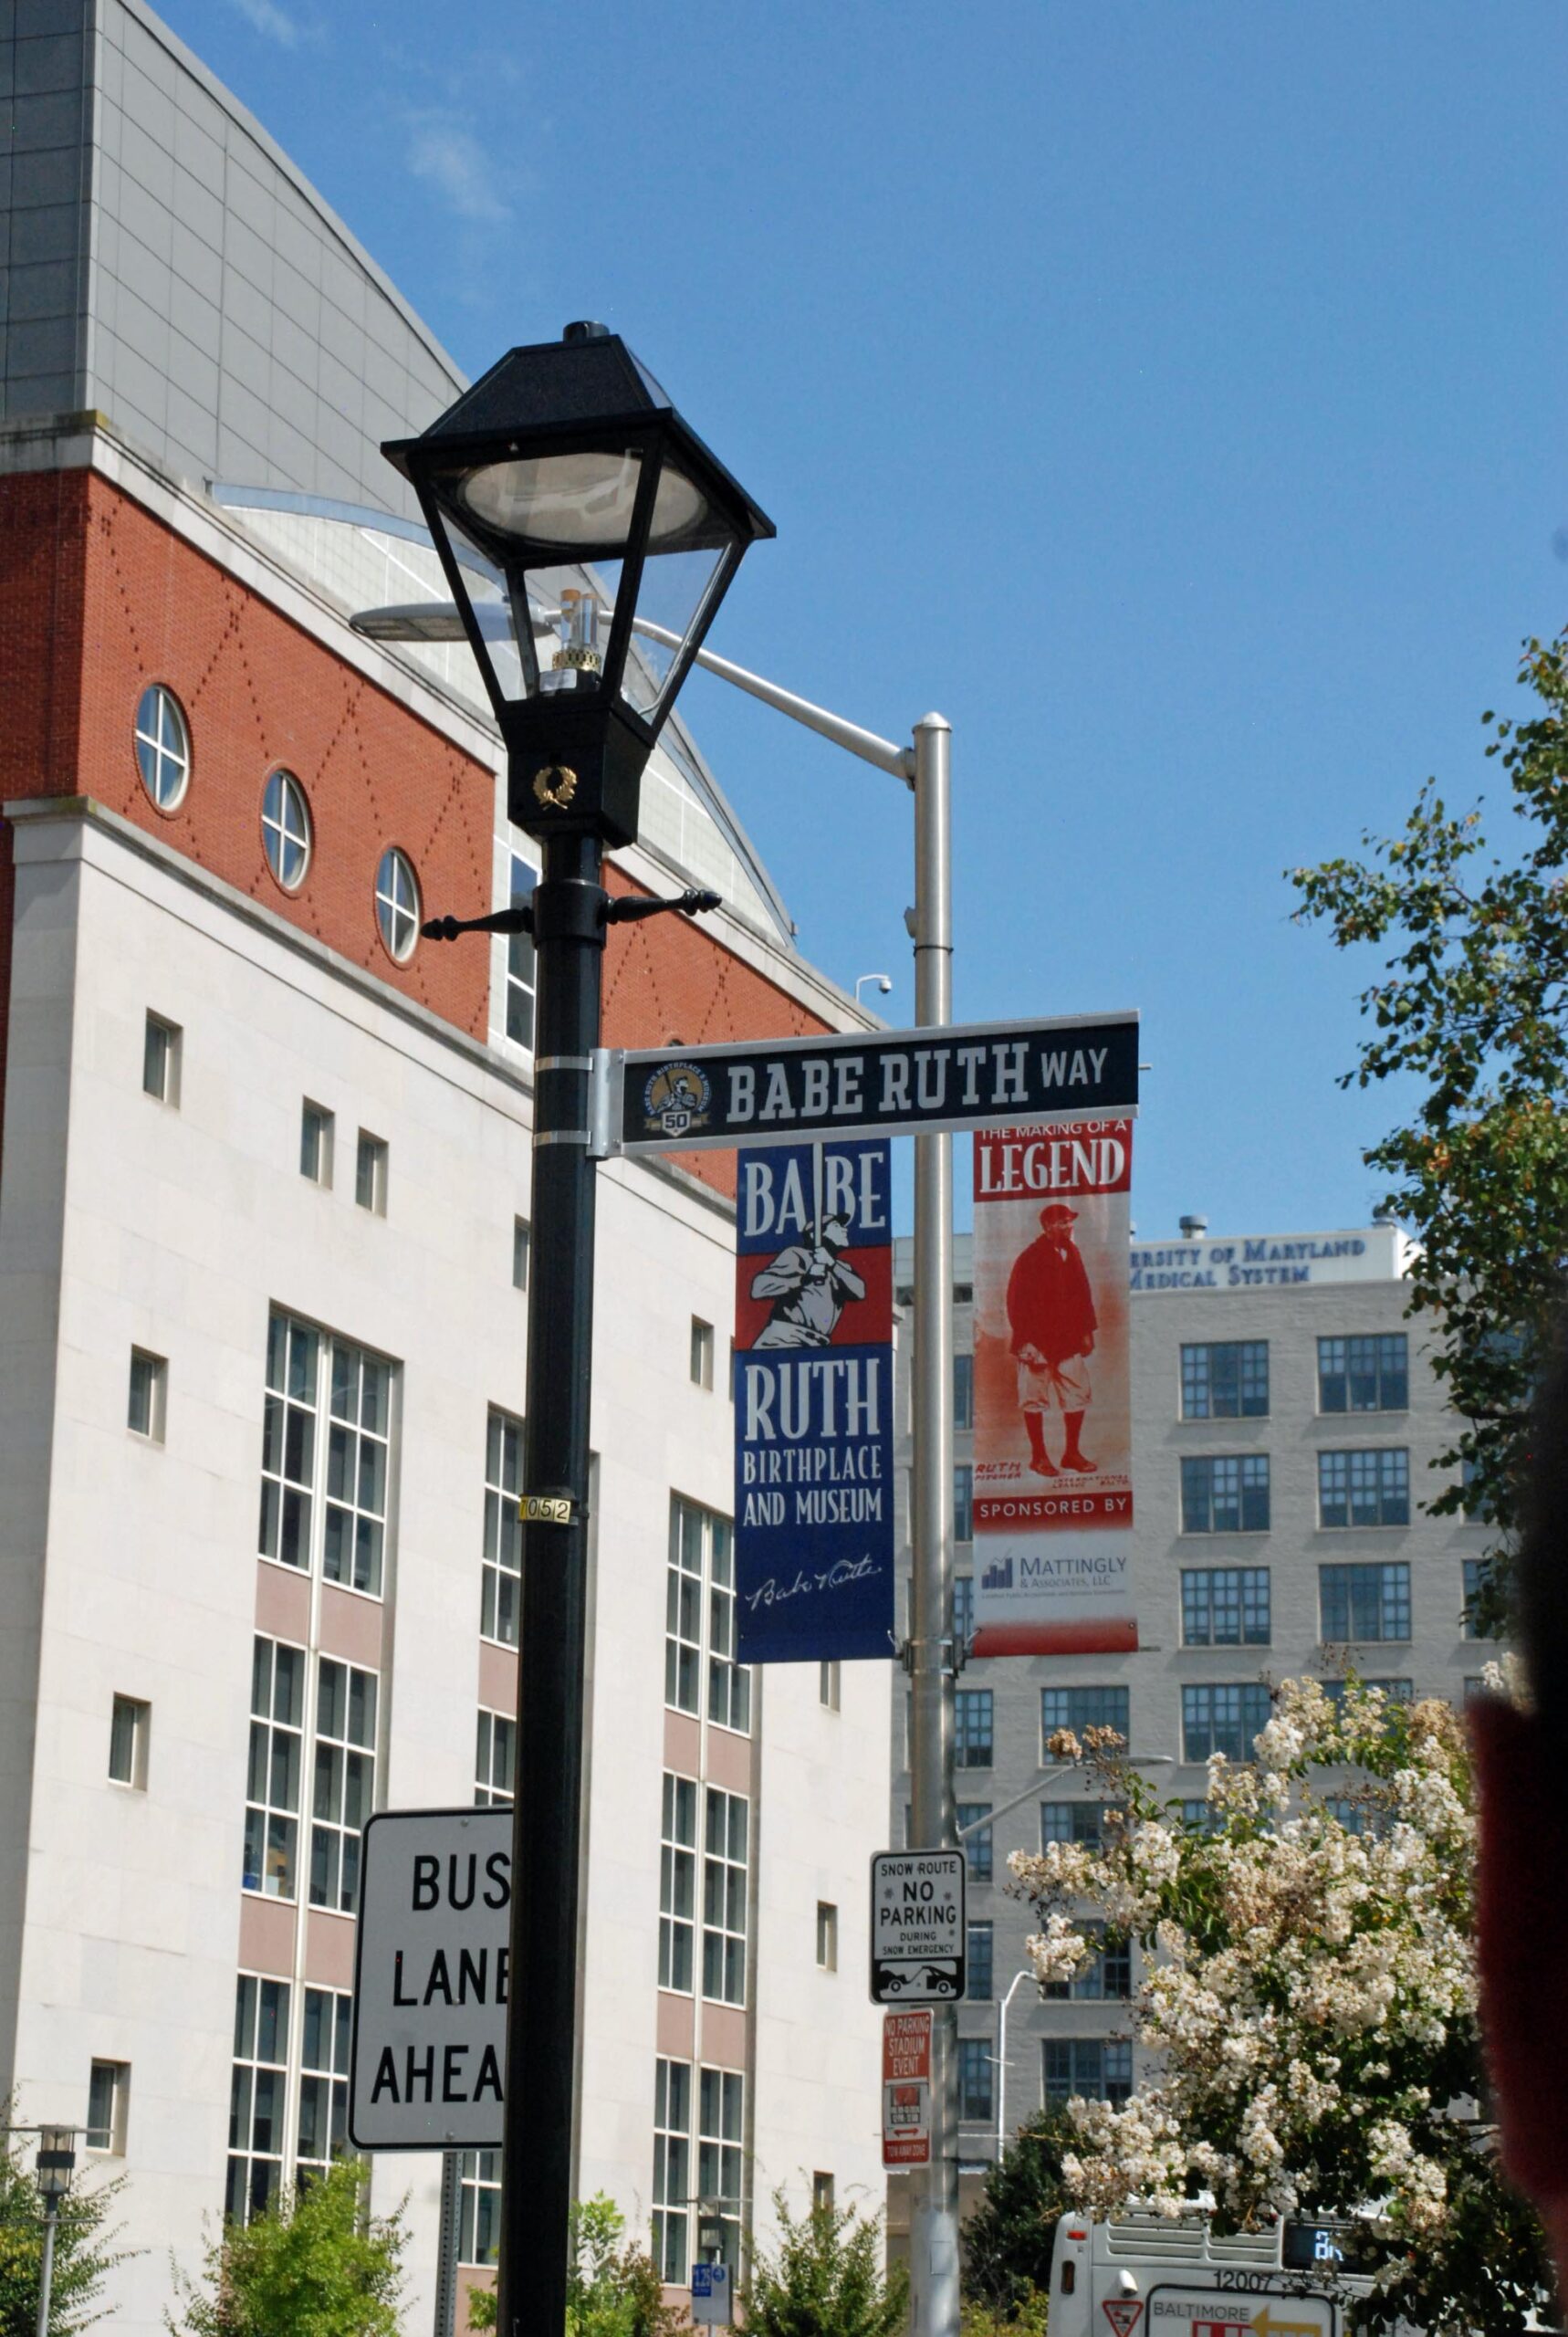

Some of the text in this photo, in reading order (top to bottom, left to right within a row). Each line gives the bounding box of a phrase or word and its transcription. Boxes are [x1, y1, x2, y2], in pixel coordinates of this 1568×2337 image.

[727, 1042, 1108, 1123] BABE RUTH WAY
[665, 1114, 687, 1128] 50
[981, 1119, 1127, 1140] THE MAKING OF A
[979, 1138, 1125, 1193] LEGEND
[744, 1152, 886, 1237] BABE
[1130, 1239, 1365, 1268] ERSITY OF MARYLAND
[1228, 1264, 1310, 1286] SYSTEM
[745, 1358, 880, 1441] RUTH
[743, 1445, 882, 1484] BIRTHPLACE
[975, 1462, 1021, 1473] RUTH
[743, 1488, 883, 1526] AND MUSEUM
[980, 1498, 1127, 1518] SPONSORED BY
[1020, 1578, 1029, 1588] &
[1092, 1576, 1112, 1586] LLC
[881, 1860, 956, 1877] SNOW ROUTE
[412, 1852, 511, 1912] BUS
[903, 1881, 935, 1902] NO
[880, 1905, 956, 1926] PARKING
[900, 1931, 936, 1942] DURING
[883, 1944, 955, 1955] SNOW EMERGENCY
[885, 2015, 930, 2037] NO PARKING
[888, 2036, 925, 2057] STADIUM
[371, 2044, 505, 2104] AHEA
[894, 2056, 919, 2077] EVENT
[1154, 2301, 1250, 2321] BALTIMORE
